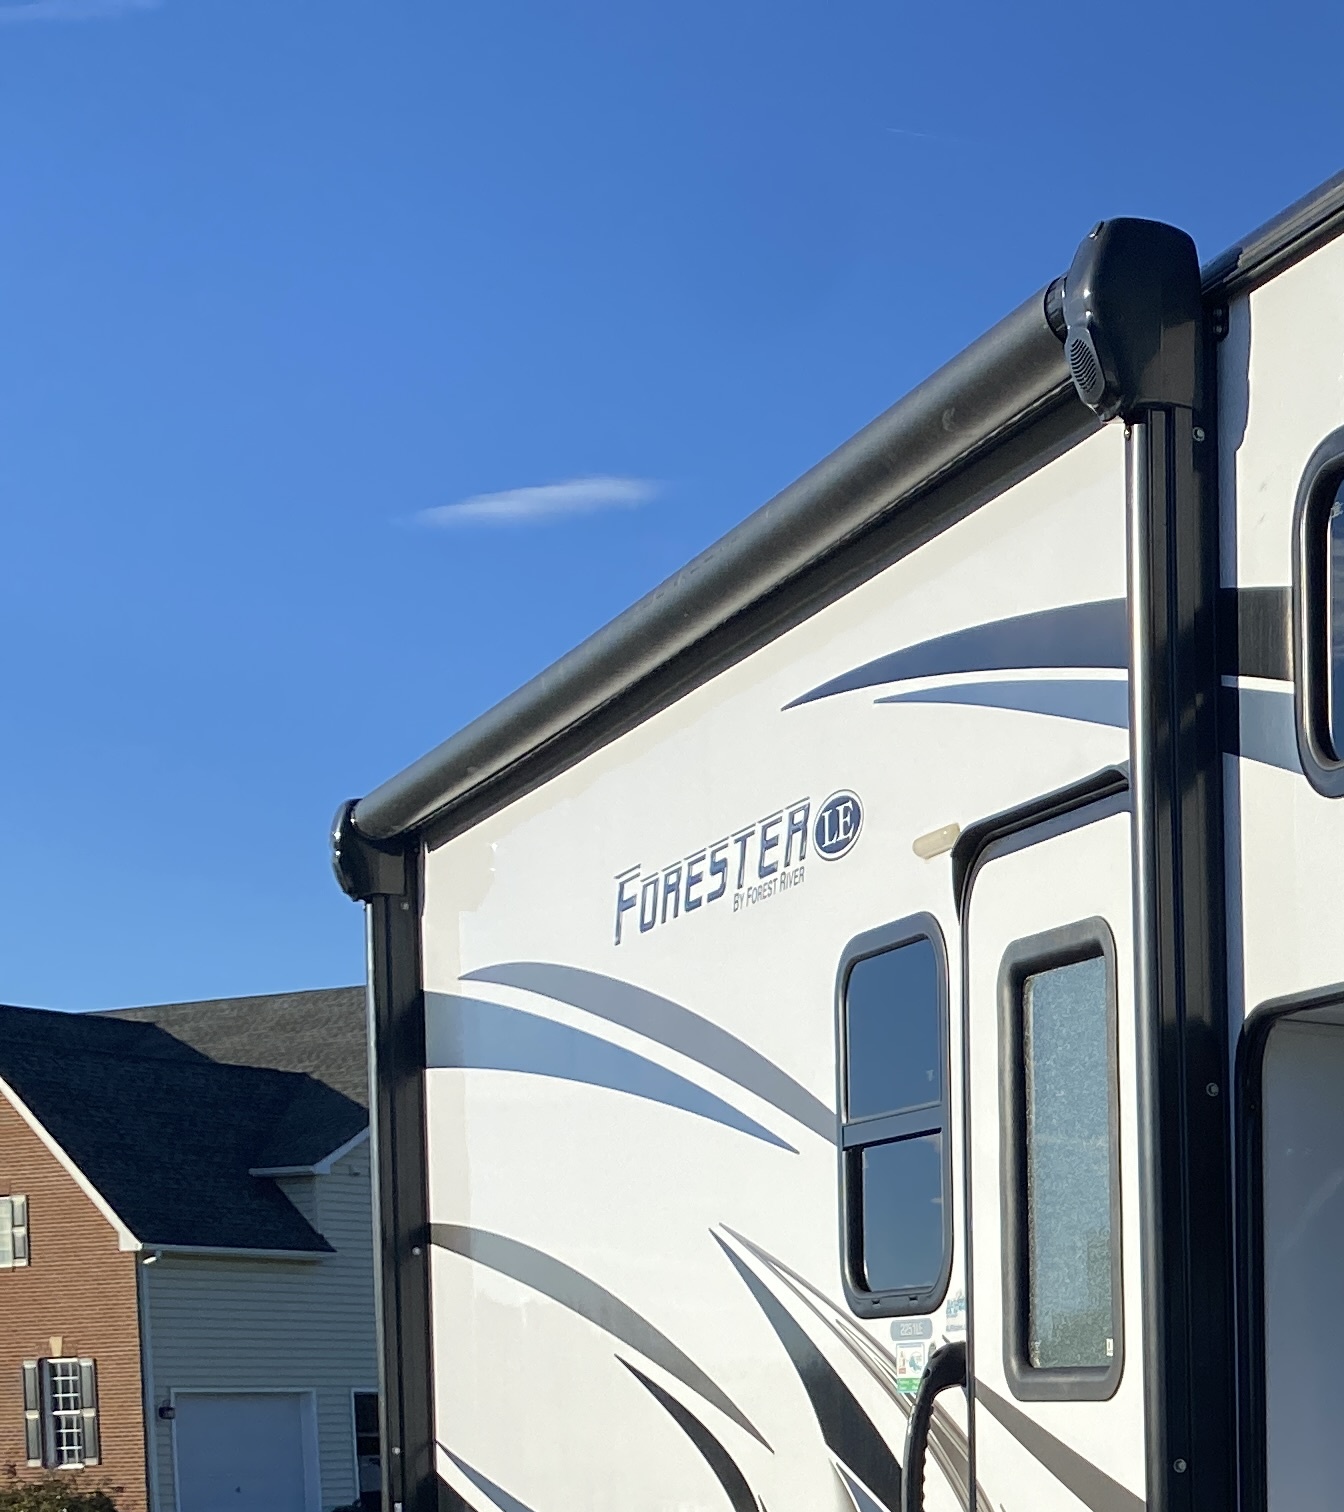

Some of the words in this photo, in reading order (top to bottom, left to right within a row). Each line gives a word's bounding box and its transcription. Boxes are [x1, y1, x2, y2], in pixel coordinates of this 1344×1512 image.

[614, 796, 811, 946] FORESTER
[820, 800, 856, 848] LE
[733, 892, 745, 912] BY
[746, 877, 778, 907] FOREST
[780, 865, 805, 891] RIVER
